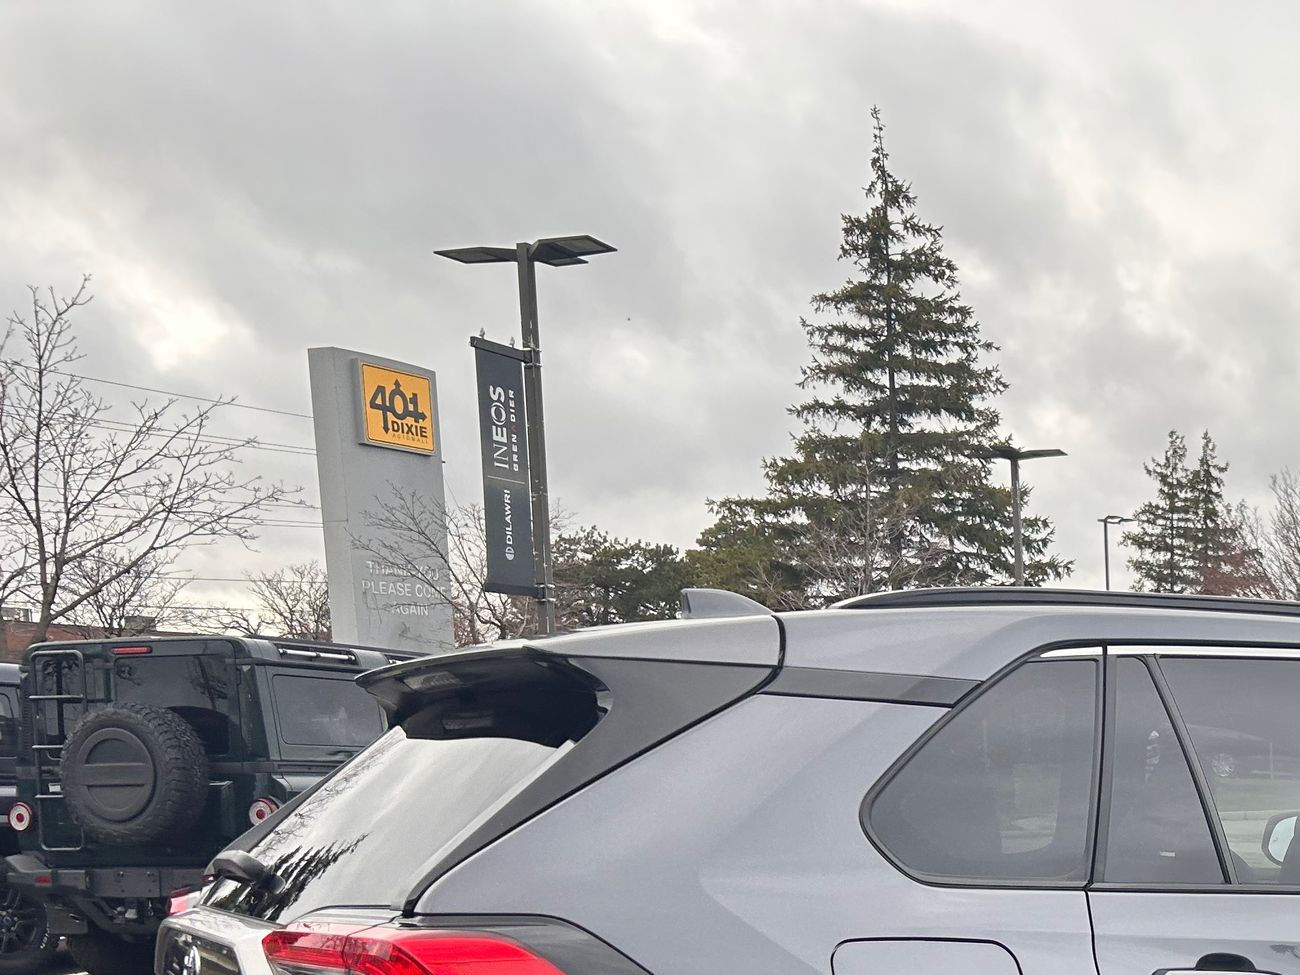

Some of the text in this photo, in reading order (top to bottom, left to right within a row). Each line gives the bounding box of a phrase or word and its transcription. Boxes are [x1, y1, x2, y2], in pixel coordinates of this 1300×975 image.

[369, 379, 428, 434] 401
[391, 420, 428, 439] DIXIE
[489, 385, 509, 469] INEOS
[503, 489, 513, 545] DILAWRI
[362, 580, 412, 597] PLEASE
